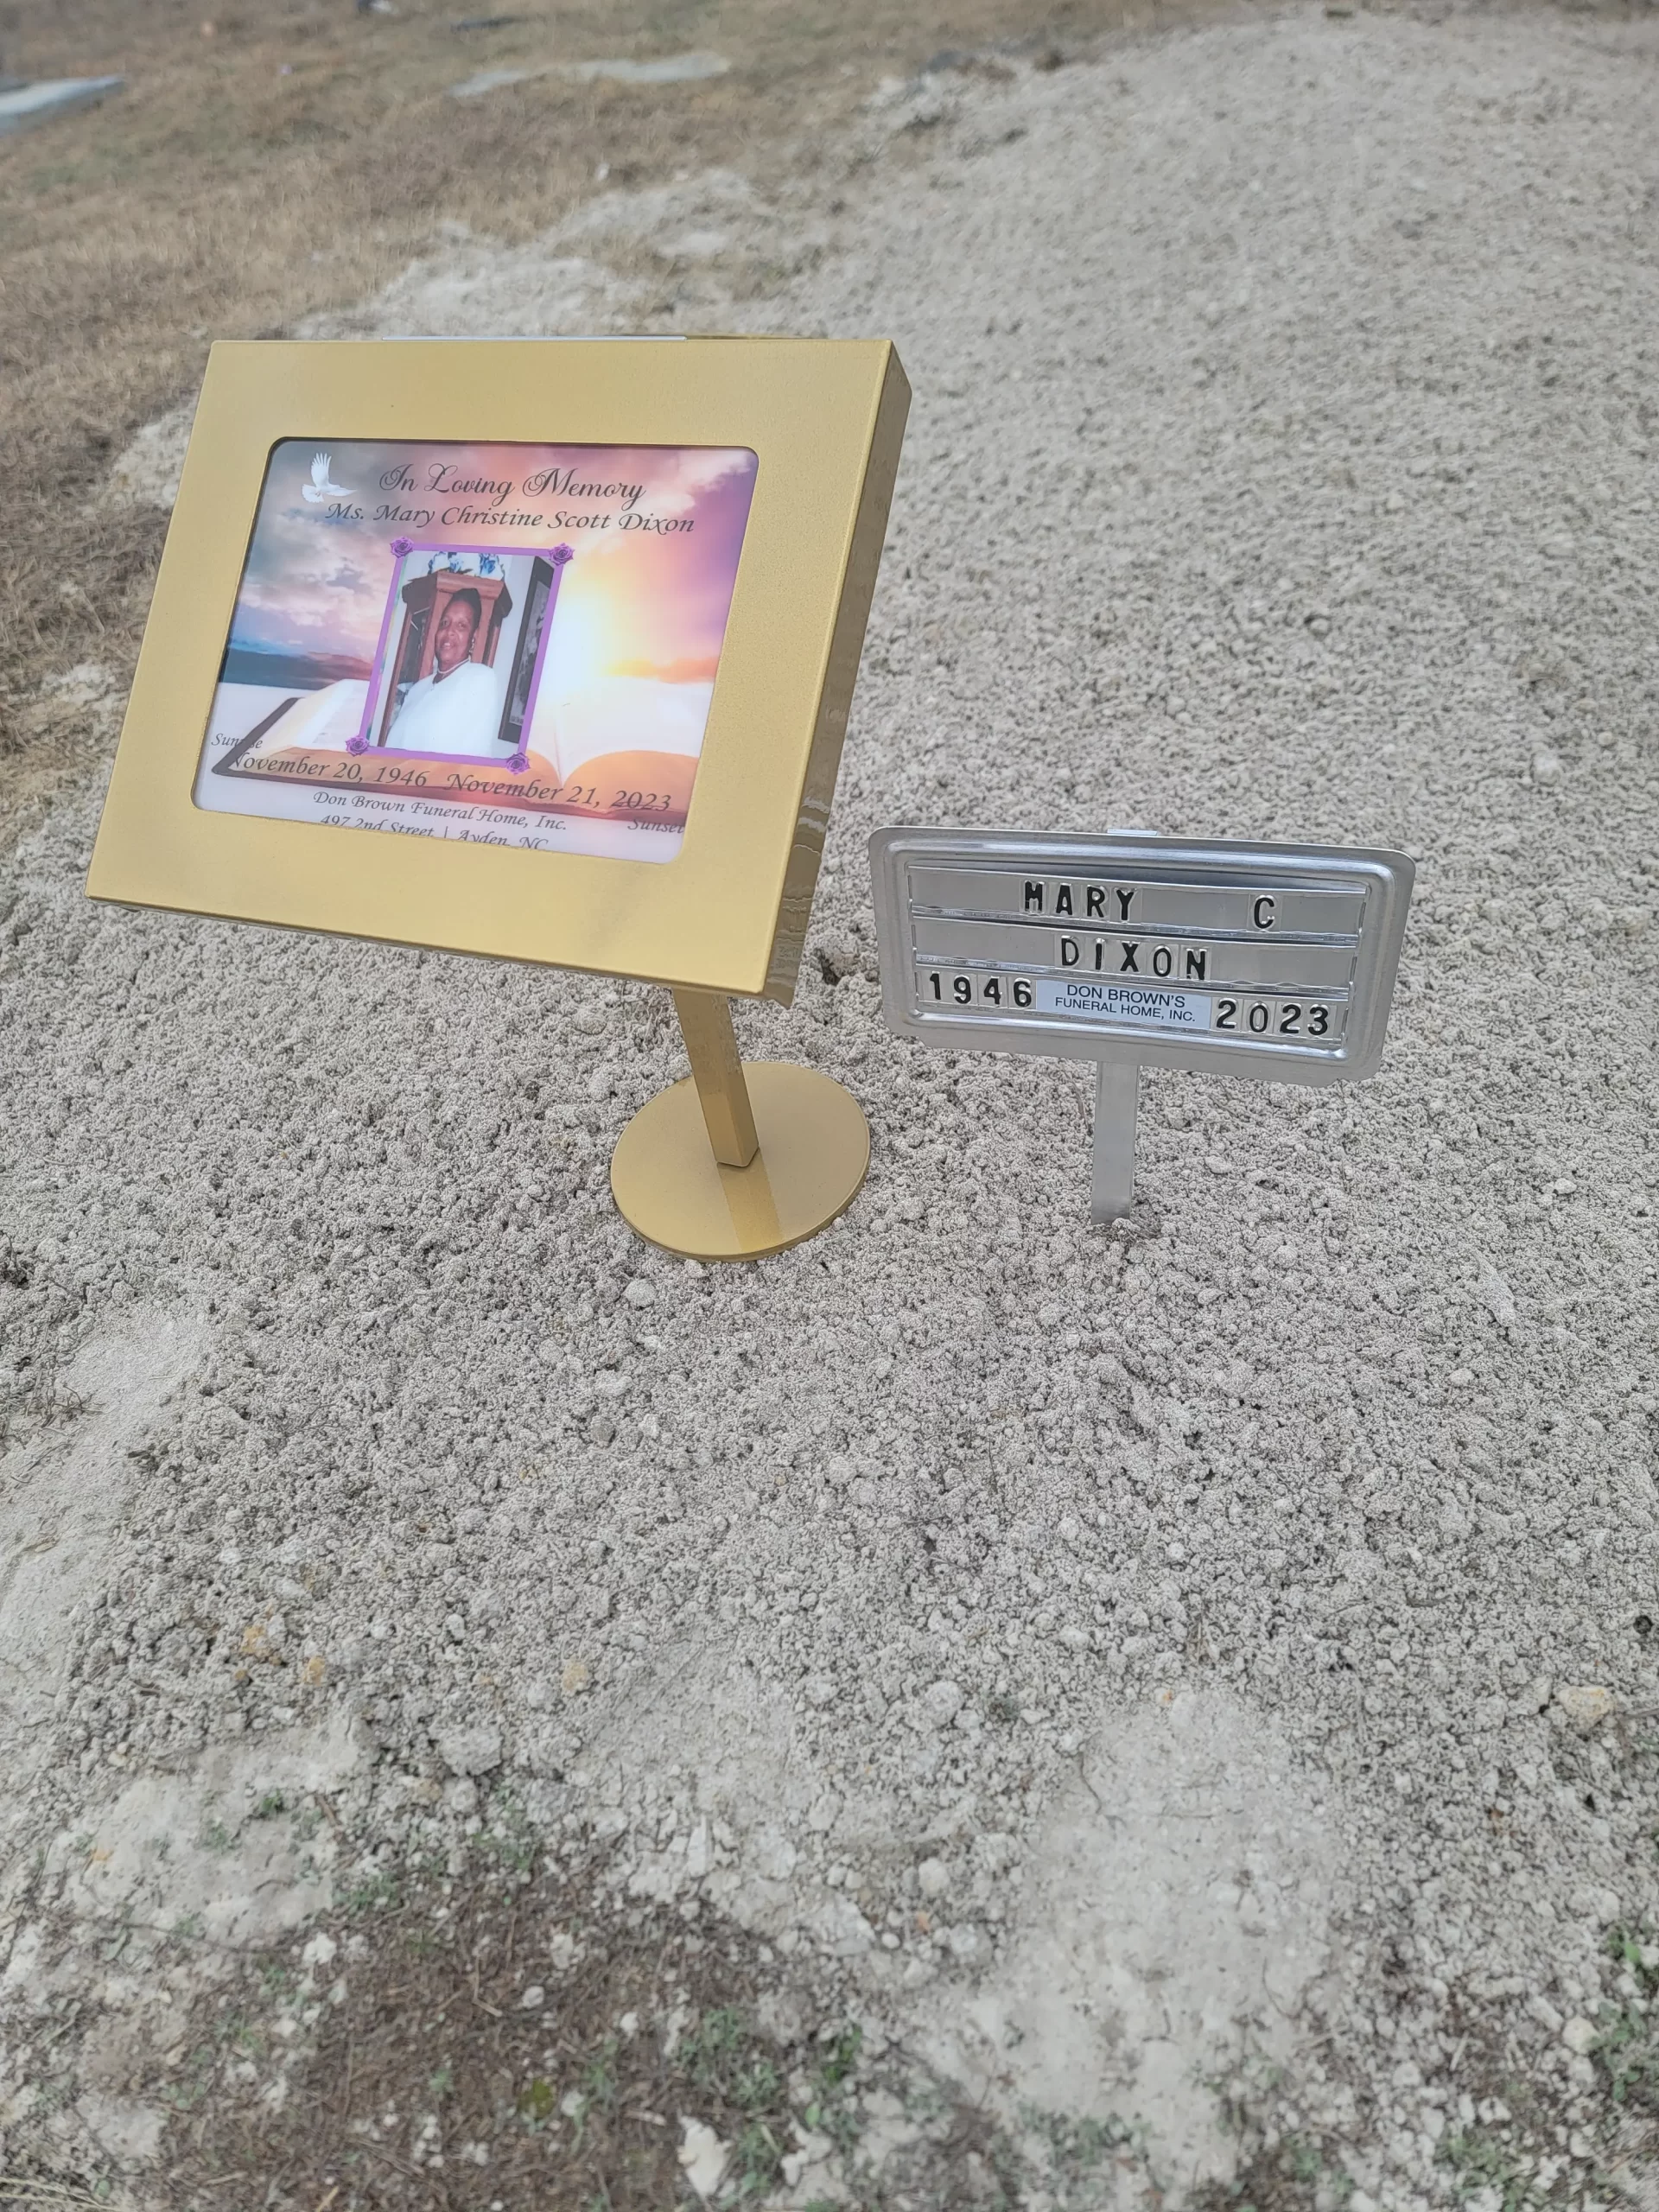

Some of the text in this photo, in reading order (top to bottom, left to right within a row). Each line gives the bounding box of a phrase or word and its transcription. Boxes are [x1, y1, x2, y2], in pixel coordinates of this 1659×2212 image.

[379, 463, 647, 512] In Loving Memory
[325, 503, 695, 533] Ms. Mary Christine Scott Dixon
[211, 733, 263, 749] Sunrse
[332, 762, 364, 785] 20,
[372, 766, 430, 788] 1946
[447, 773, 672, 812] November 21, 2023
[313, 791, 568, 831] Don Brown Funeral Home, Inc.
[321, 814, 351, 827] 497
[390, 822, 435, 837] Street
[1024, 880, 1276, 930] MARY C
[1059, 935, 1208, 981] DIXON
[929, 973, 1033, 1008] 1946
[1066, 984, 1186, 1008] DON BROWN'S
[1055, 996, 1196, 1022] FUNERAL HOME, INC.
[1216, 999, 1330, 1036] 2023
